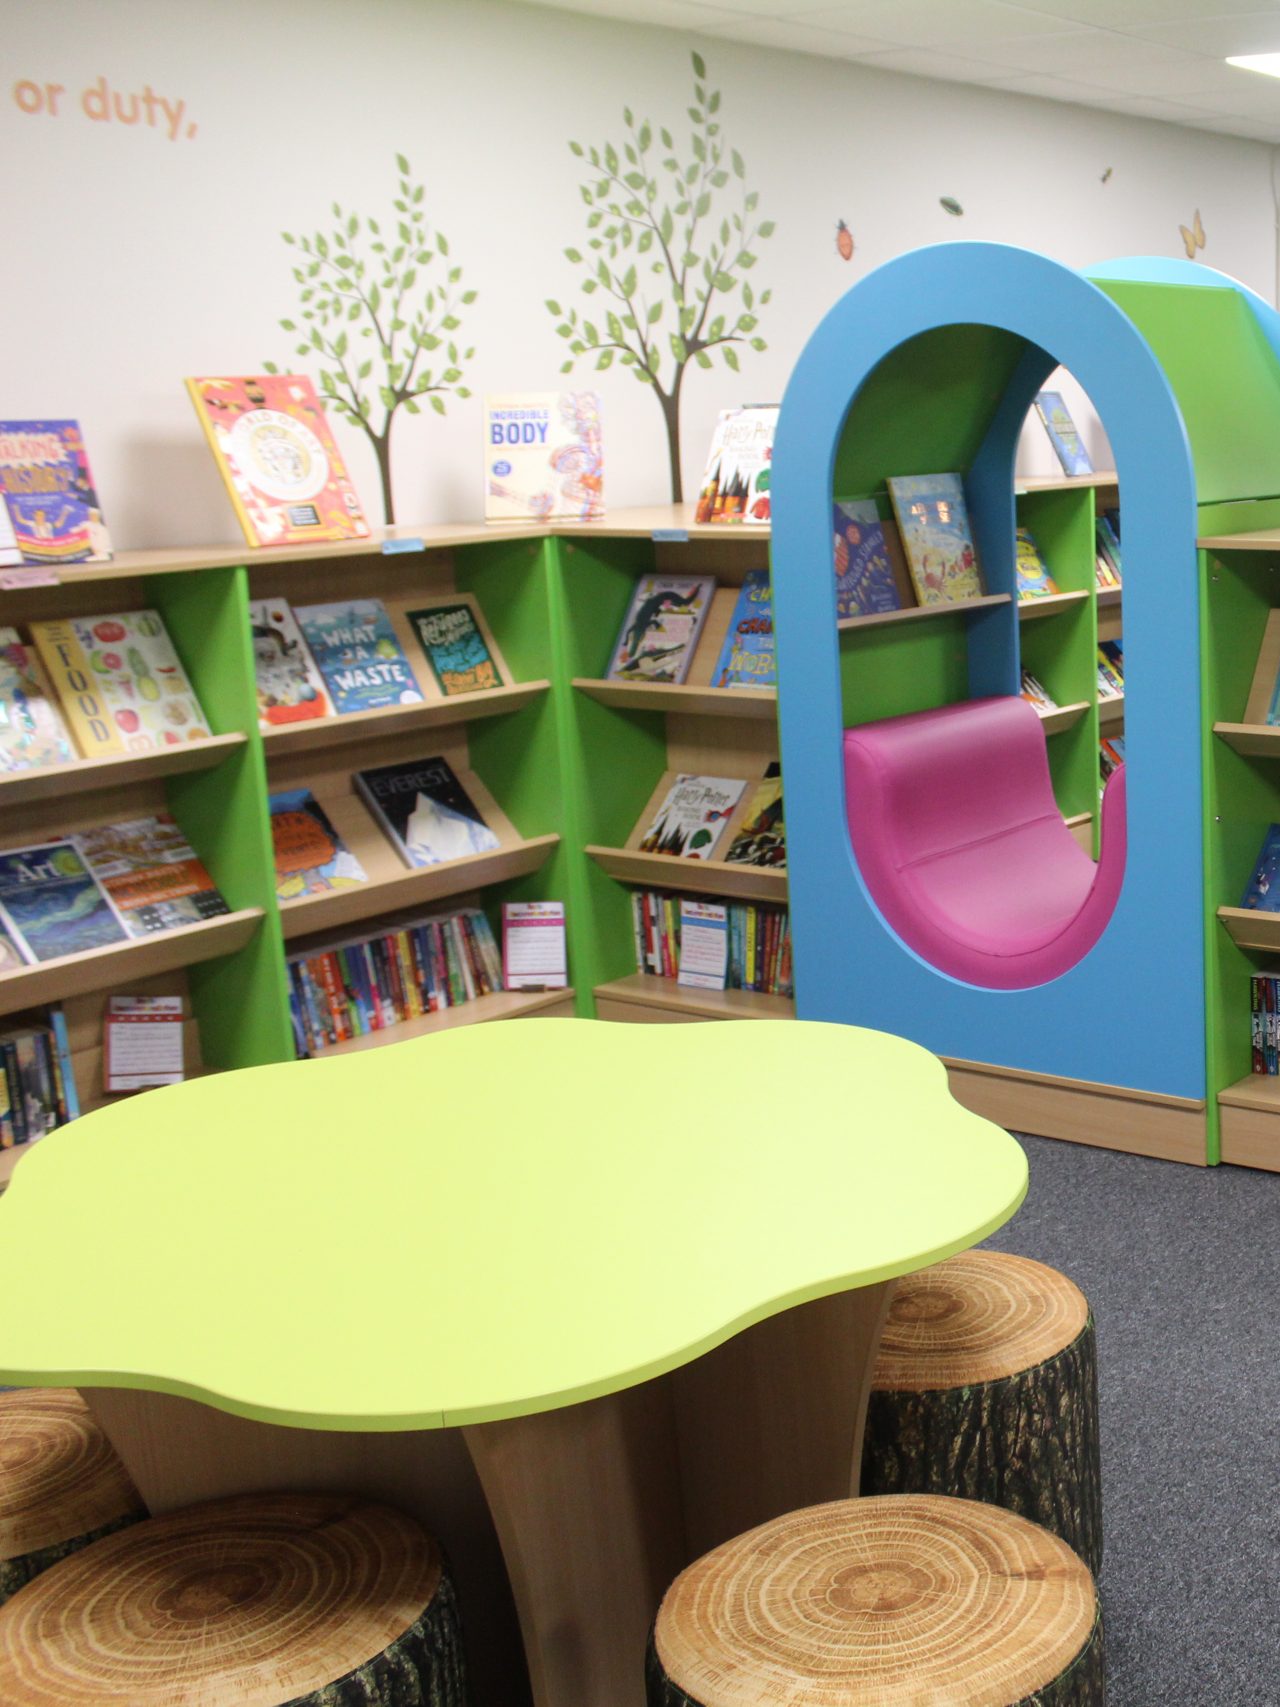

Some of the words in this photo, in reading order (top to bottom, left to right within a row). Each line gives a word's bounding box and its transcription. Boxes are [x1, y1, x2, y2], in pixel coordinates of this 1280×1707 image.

[12, 78, 65, 116] or
[82, 77, 198, 141] duty,
[491, 422, 549, 445] BODY
[322, 625, 377, 647] WHAT
[356, 649, 369, 661] A
[334, 663, 406, 691] WASTE
[56, 643, 110, 742] FOOD
[372, 767, 450, 797] EVEREST
[17, 862, 61, 883] Art
